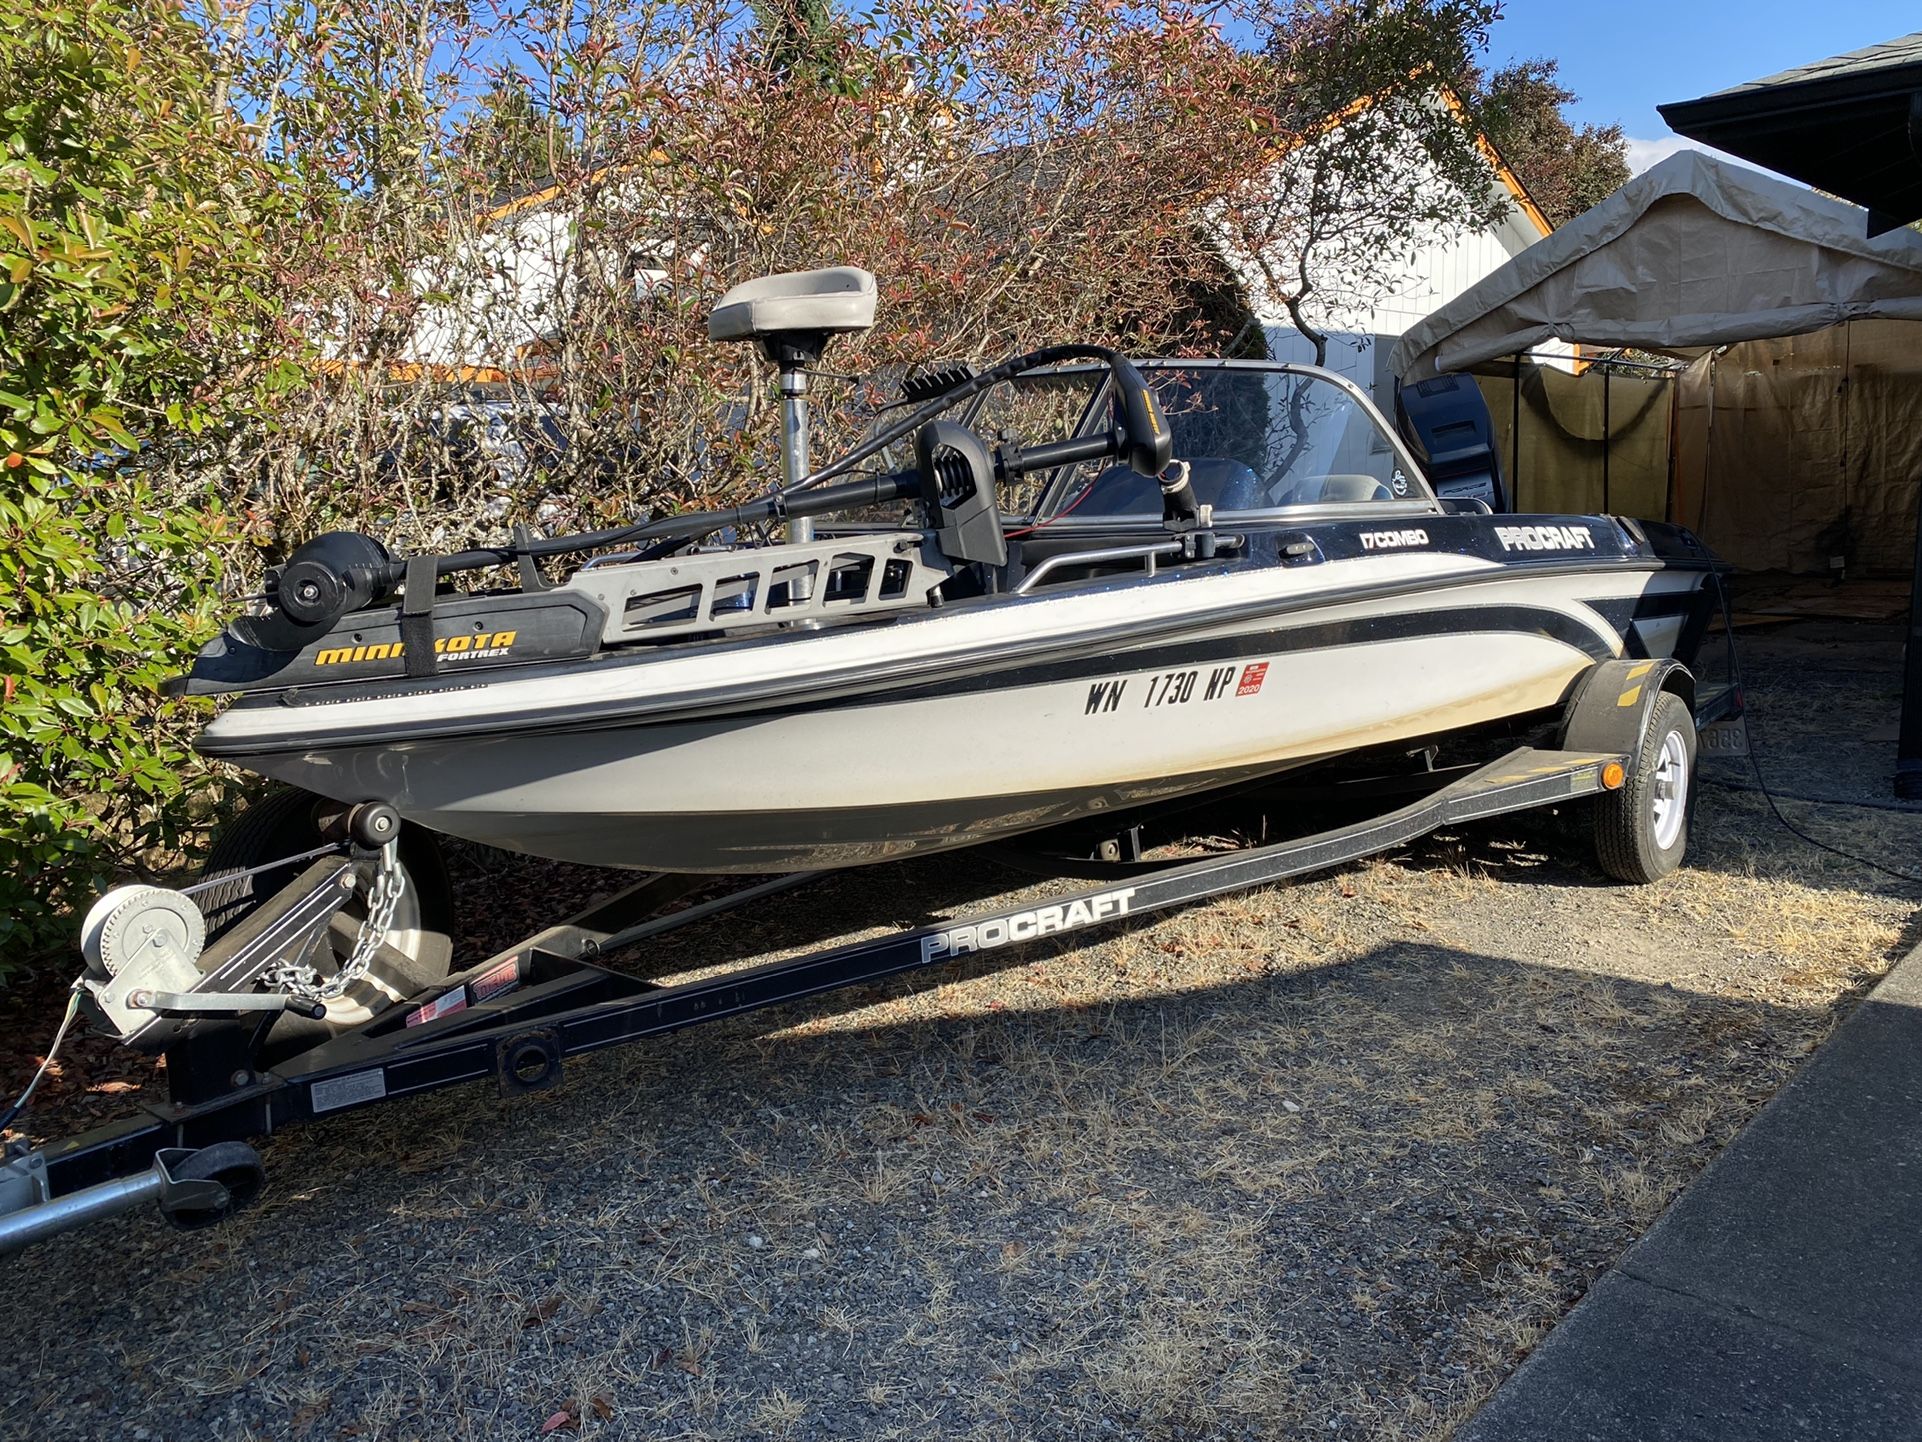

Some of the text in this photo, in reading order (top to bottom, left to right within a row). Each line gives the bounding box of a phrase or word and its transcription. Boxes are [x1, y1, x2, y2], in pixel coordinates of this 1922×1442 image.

[1494, 524, 1595, 552] PROCRAFT
[436, 647, 510, 663] FORTREX
[1085, 680, 1128, 715] WN
[1144, 671, 1198, 708] 1730
[1238, 684, 1260, 695] 2020
[920, 888, 1136, 964] PROCRAFT
